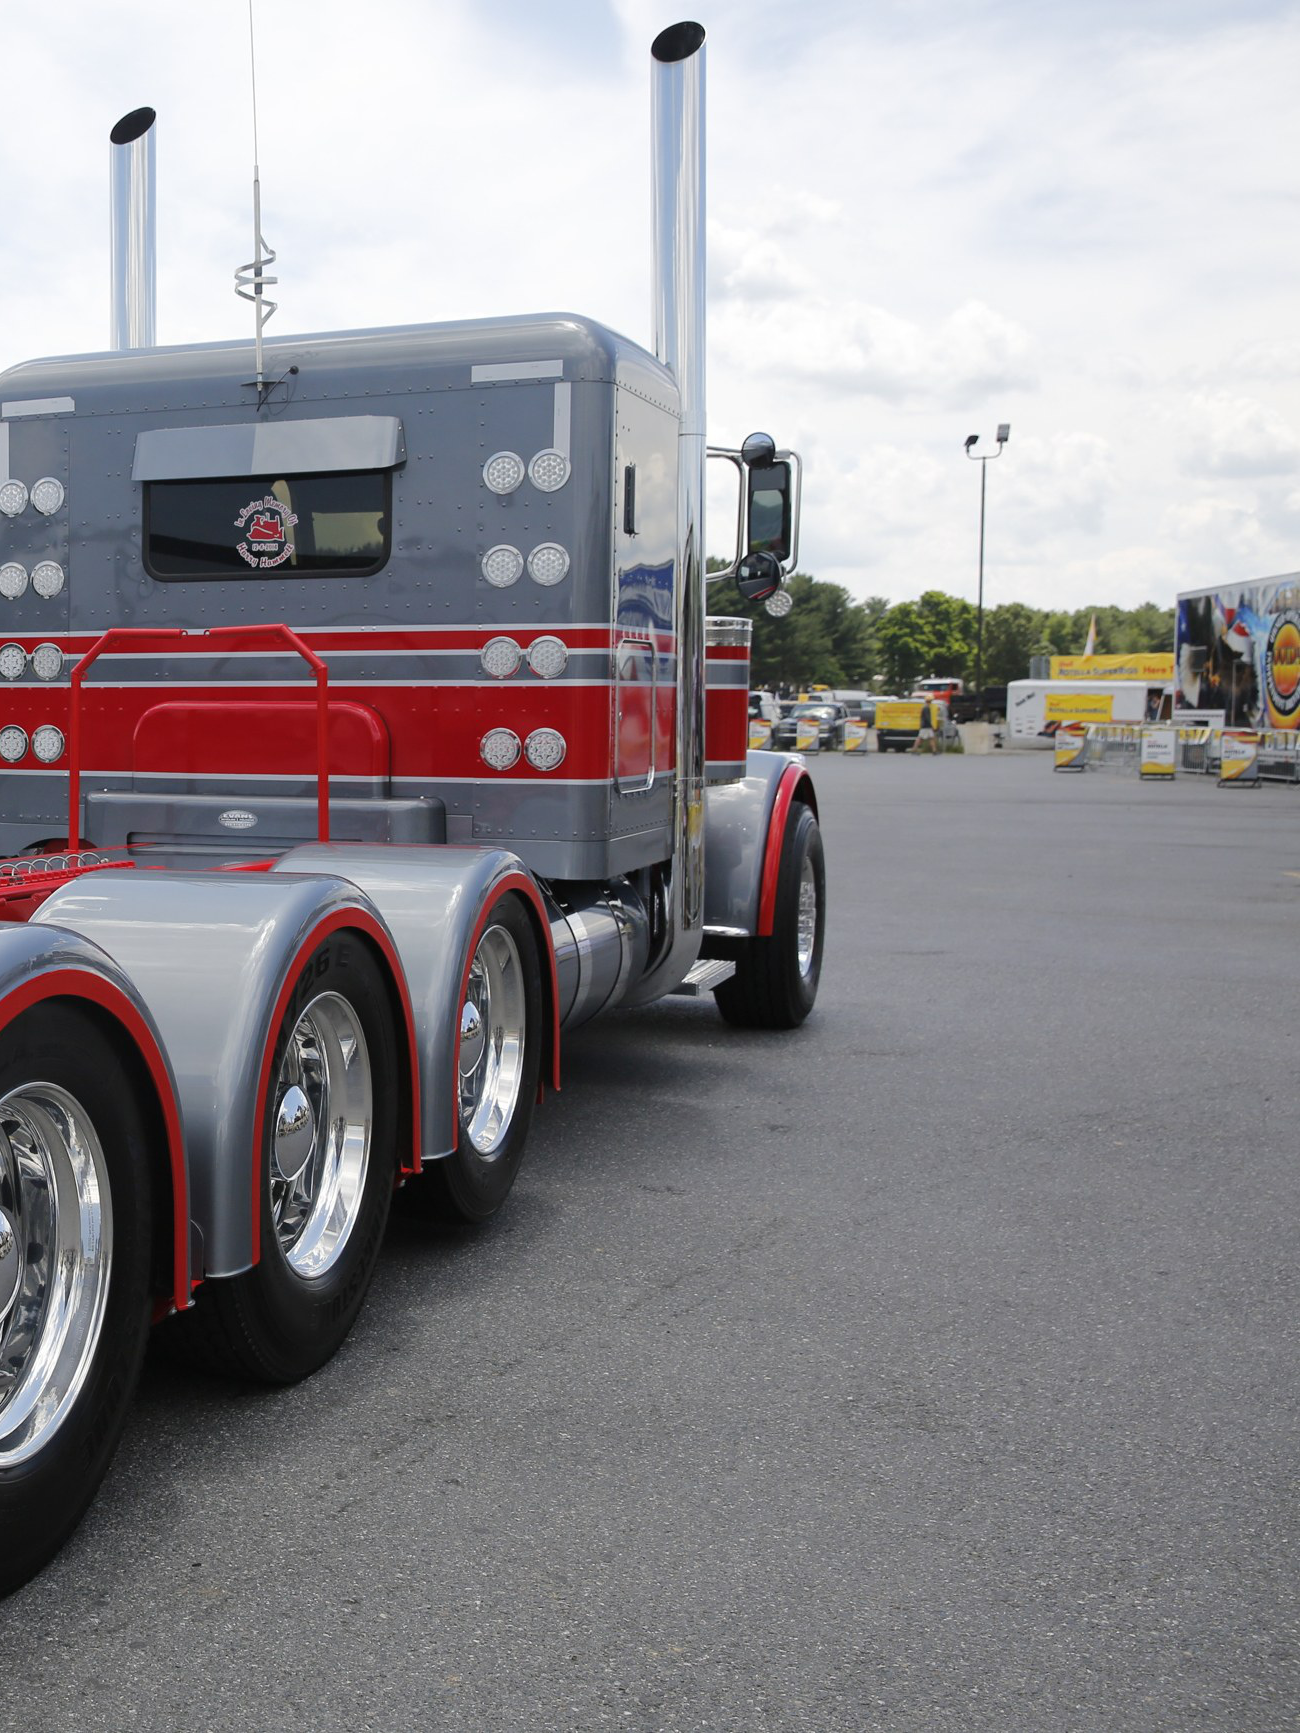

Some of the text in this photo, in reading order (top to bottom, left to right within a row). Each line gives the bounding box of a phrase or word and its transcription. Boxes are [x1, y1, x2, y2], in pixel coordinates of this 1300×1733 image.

[240, 501, 263, 519] Loving
[264, 496, 291, 518] Memory
[259, 543, 294, 567] Hammett
